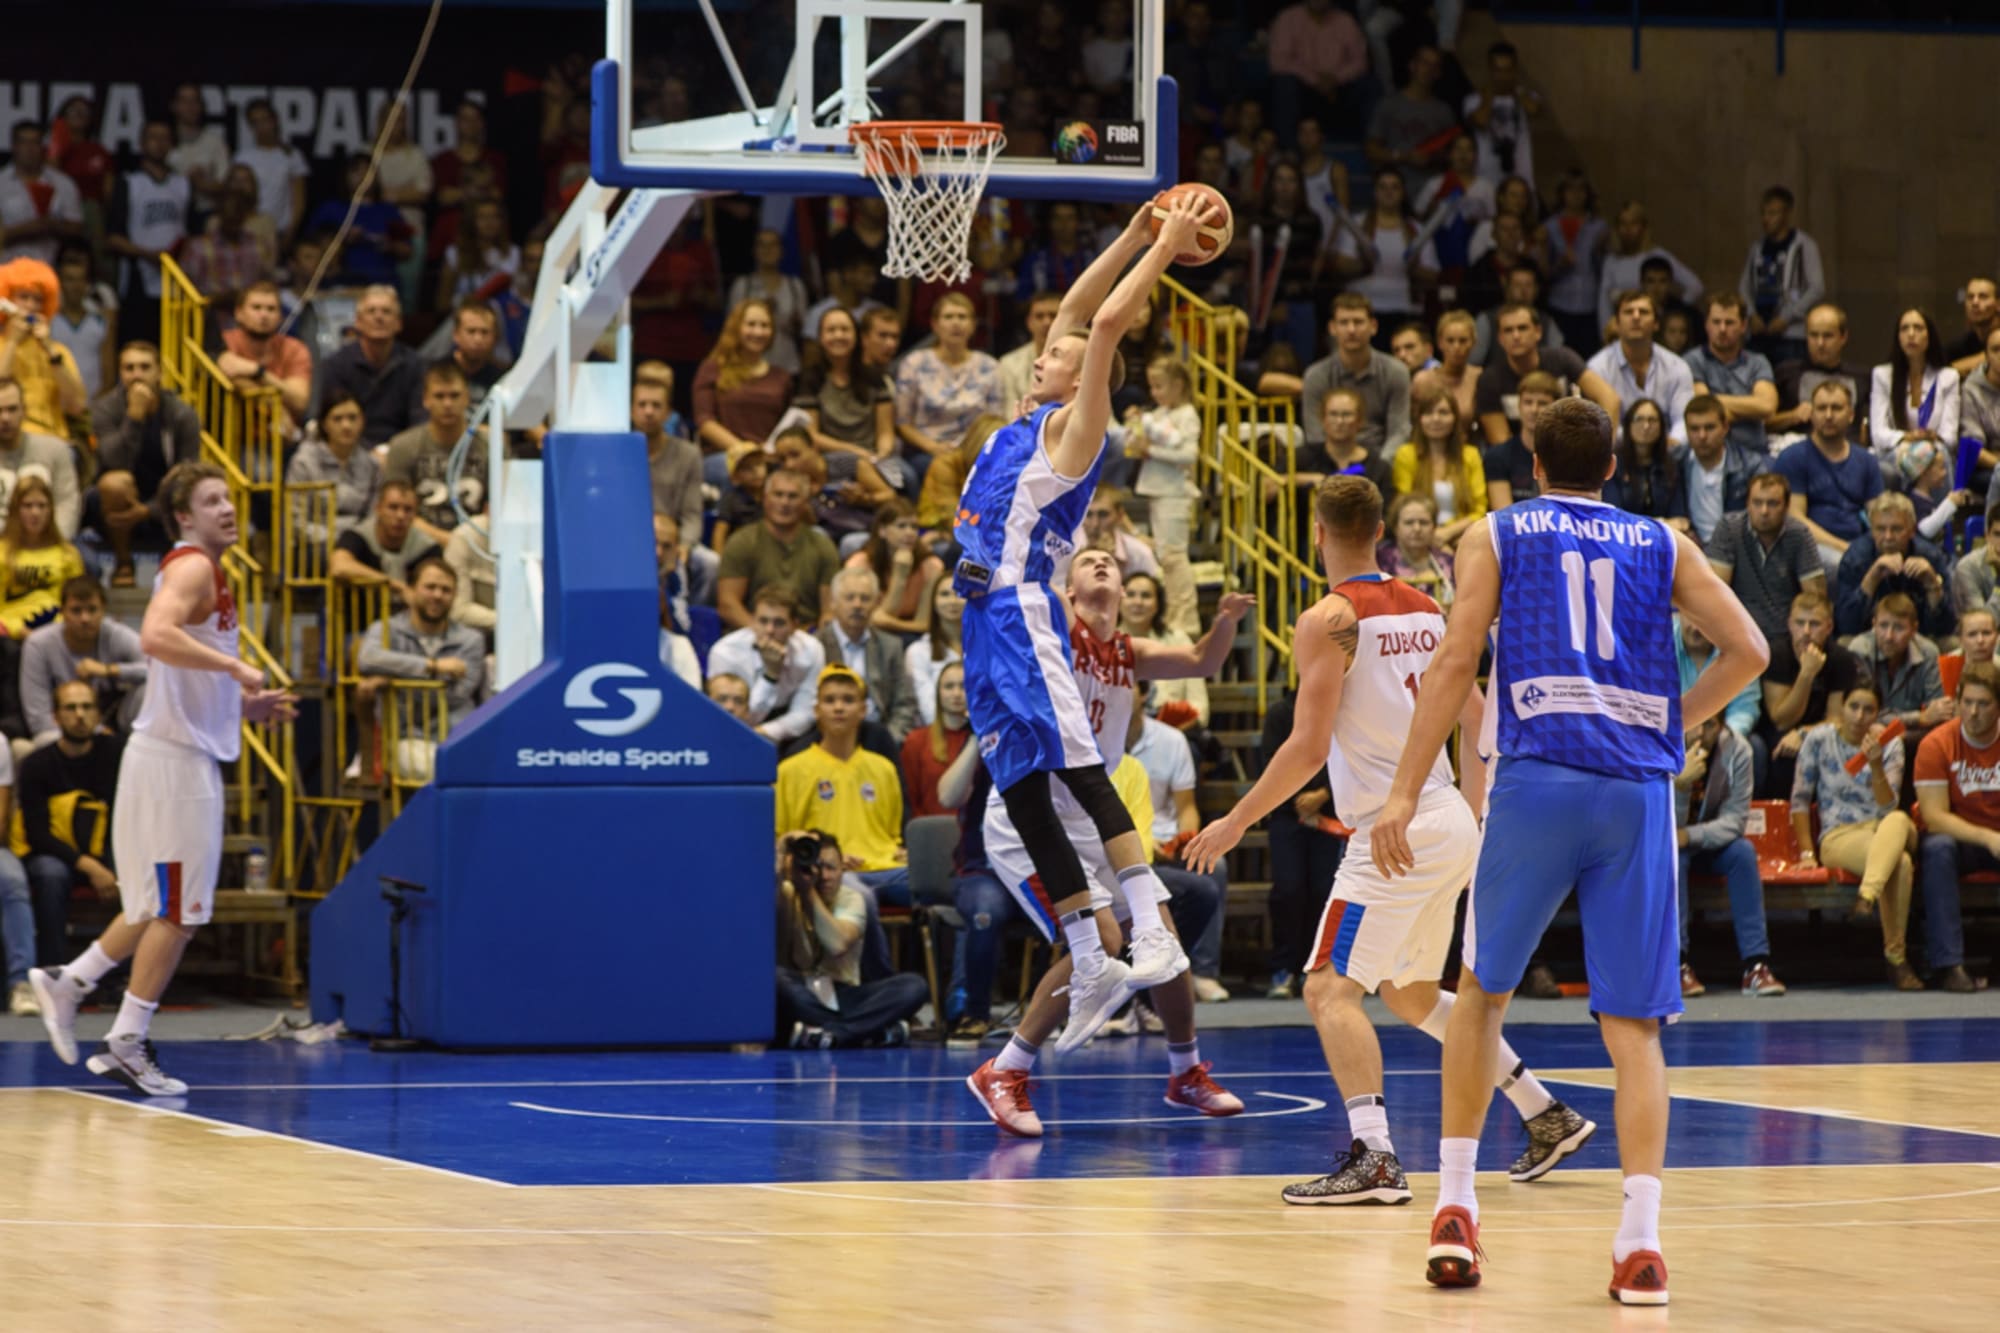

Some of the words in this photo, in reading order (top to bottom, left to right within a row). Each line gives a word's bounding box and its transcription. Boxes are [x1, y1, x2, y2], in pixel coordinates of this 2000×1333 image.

[202, 84, 486, 159] ТРАЫ
[1107, 126, 1139, 143] FIBA
[1513, 510, 1653, 547] KIKANOVIĆ
[1561, 551, 1615, 661] 11
[517, 748, 621, 767] Schelde
[624, 748, 709, 770] Sports
